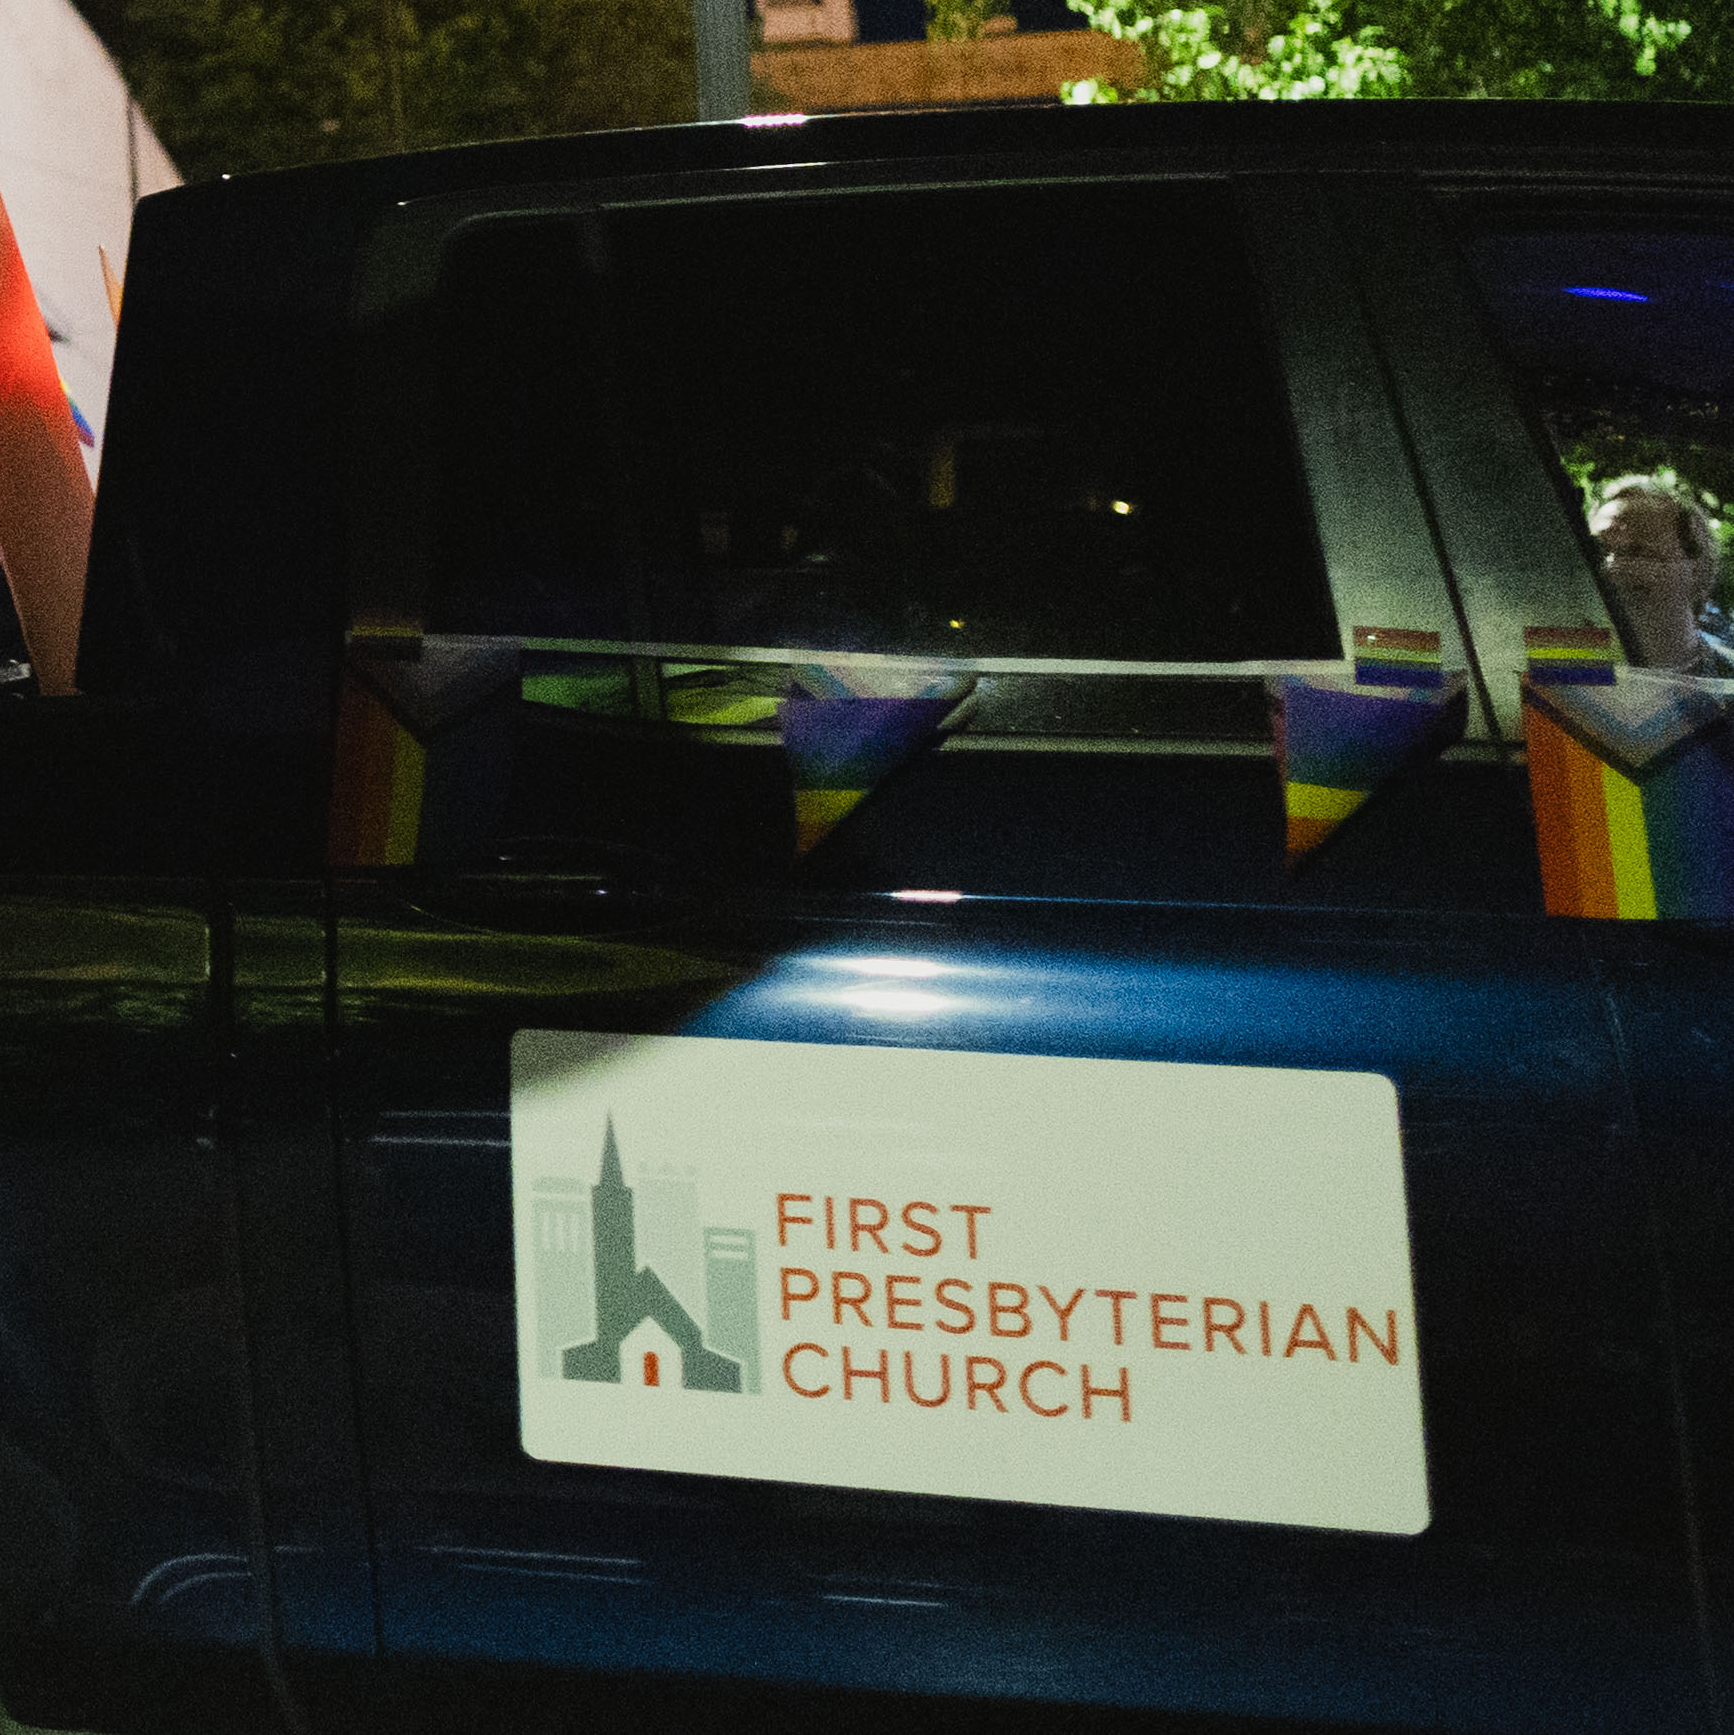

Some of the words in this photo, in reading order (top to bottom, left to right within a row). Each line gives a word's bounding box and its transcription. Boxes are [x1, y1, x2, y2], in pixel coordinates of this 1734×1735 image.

[777, 1193, 991, 1259] FIRST
[781, 1267, 1399, 1366] PRESBYTERIAN
[783, 1342, 1131, 1423] CHURCH
